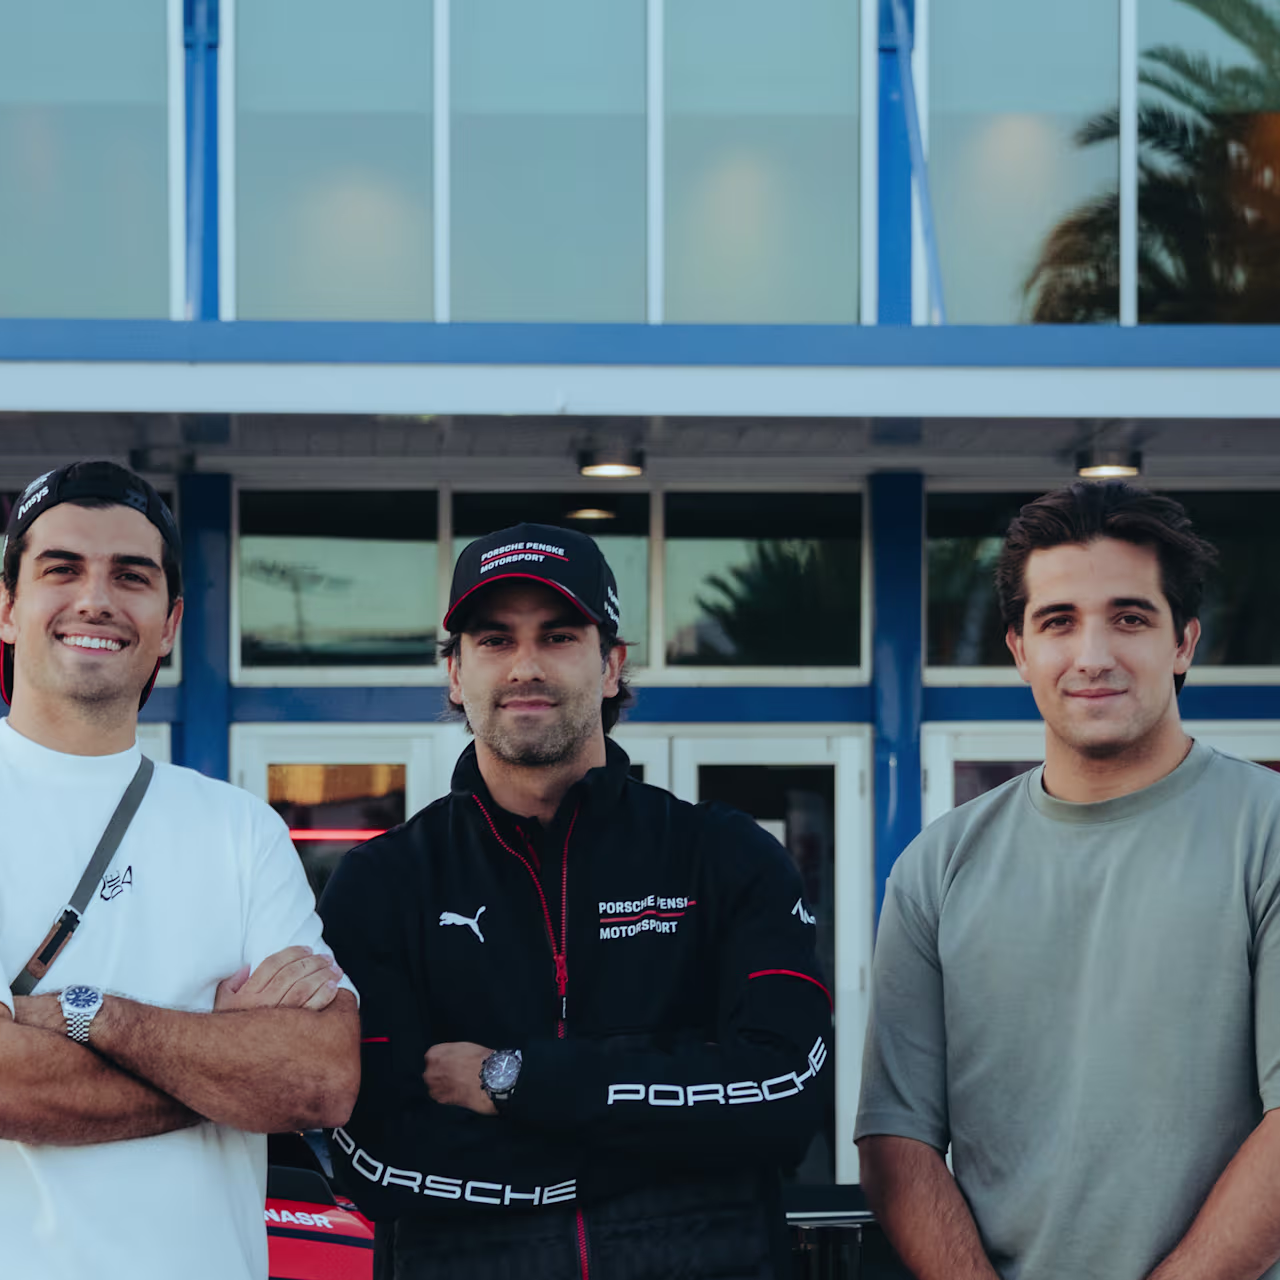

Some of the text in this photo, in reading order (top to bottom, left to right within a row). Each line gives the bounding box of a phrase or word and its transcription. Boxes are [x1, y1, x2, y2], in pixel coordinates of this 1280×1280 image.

[17, 485, 50, 520] Ansys
[480, 541, 565, 562] PORSCHE PENSKE
[480, 553, 545, 574] MOTORSPORT
[598, 895, 655, 914] PORSCHE
[599, 919, 678, 940] MOTORSPORT
[607, 1036, 828, 1106] PORSCHE
[332, 1127, 577, 1205] PORSCHE
[263, 1208, 334, 1229] NASR
